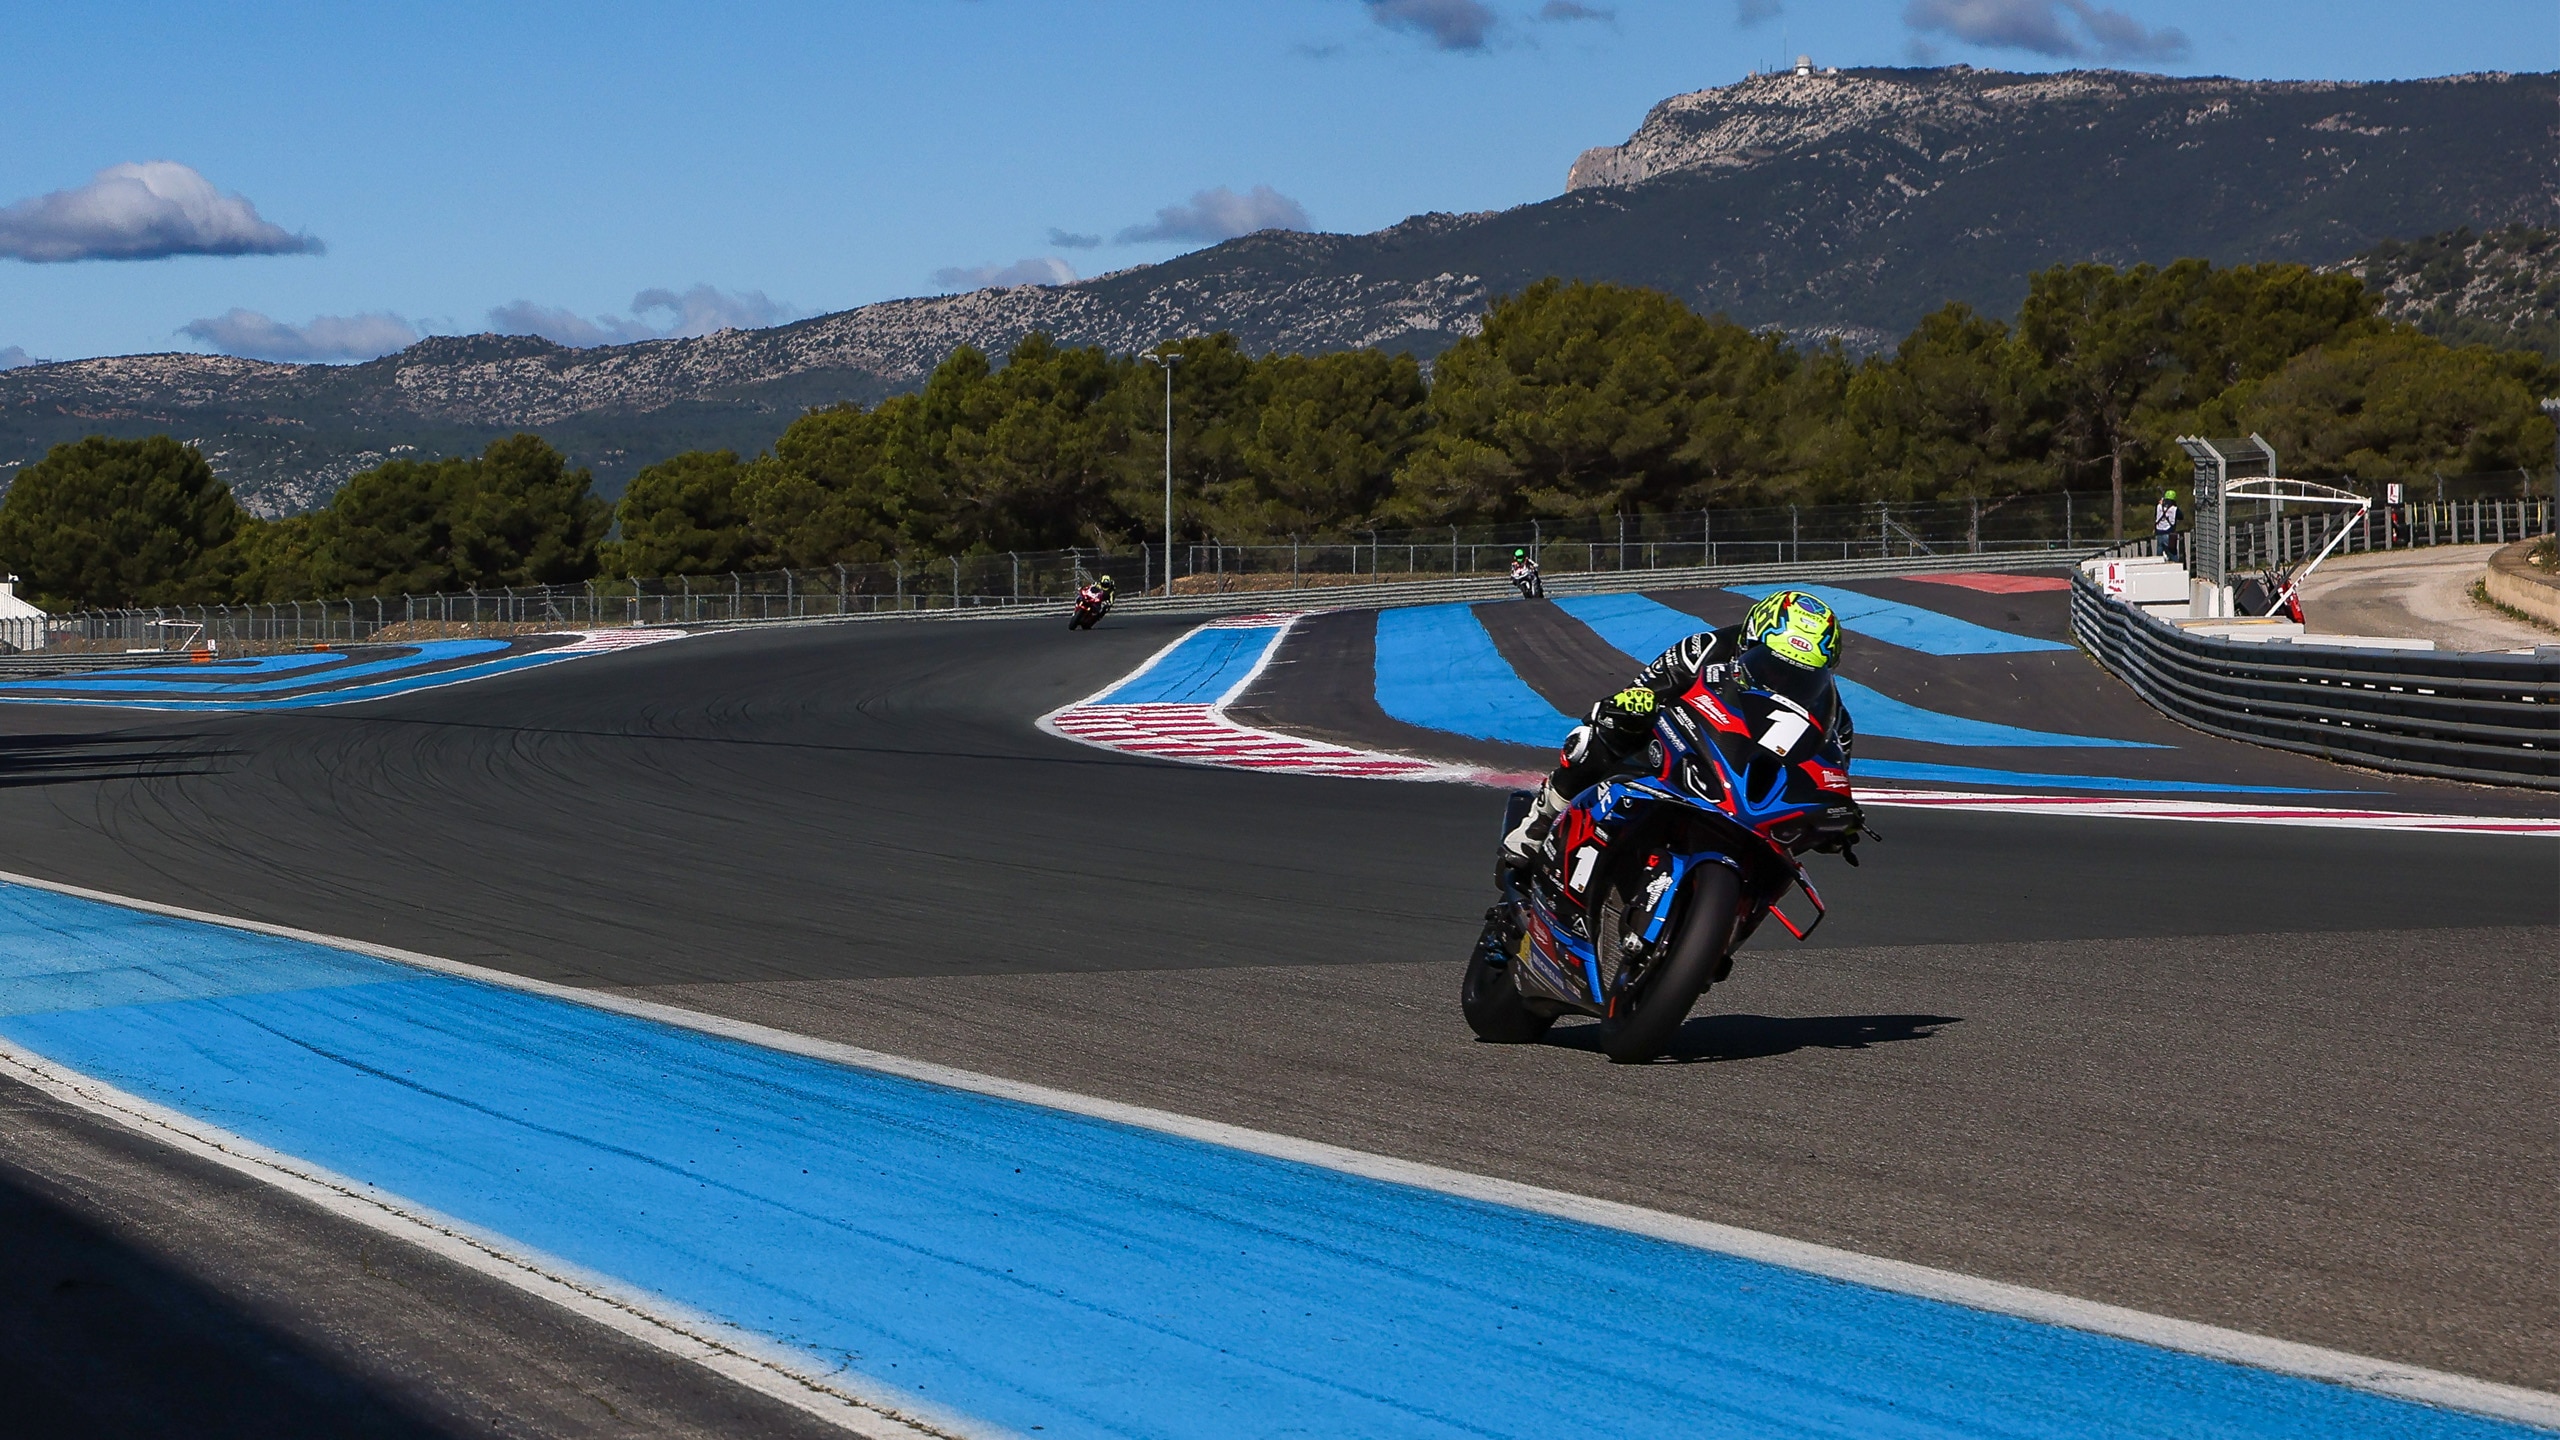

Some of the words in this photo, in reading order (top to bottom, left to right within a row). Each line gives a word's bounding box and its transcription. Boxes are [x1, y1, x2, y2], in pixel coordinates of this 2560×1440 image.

[1791, 637, 1810, 651] BELL
[1693, 694, 1731, 724] Milwaukee
[1658, 715, 1687, 750] TECMAS
[1757, 709, 1811, 757] 1
[1569, 845, 1599, 893] 1
